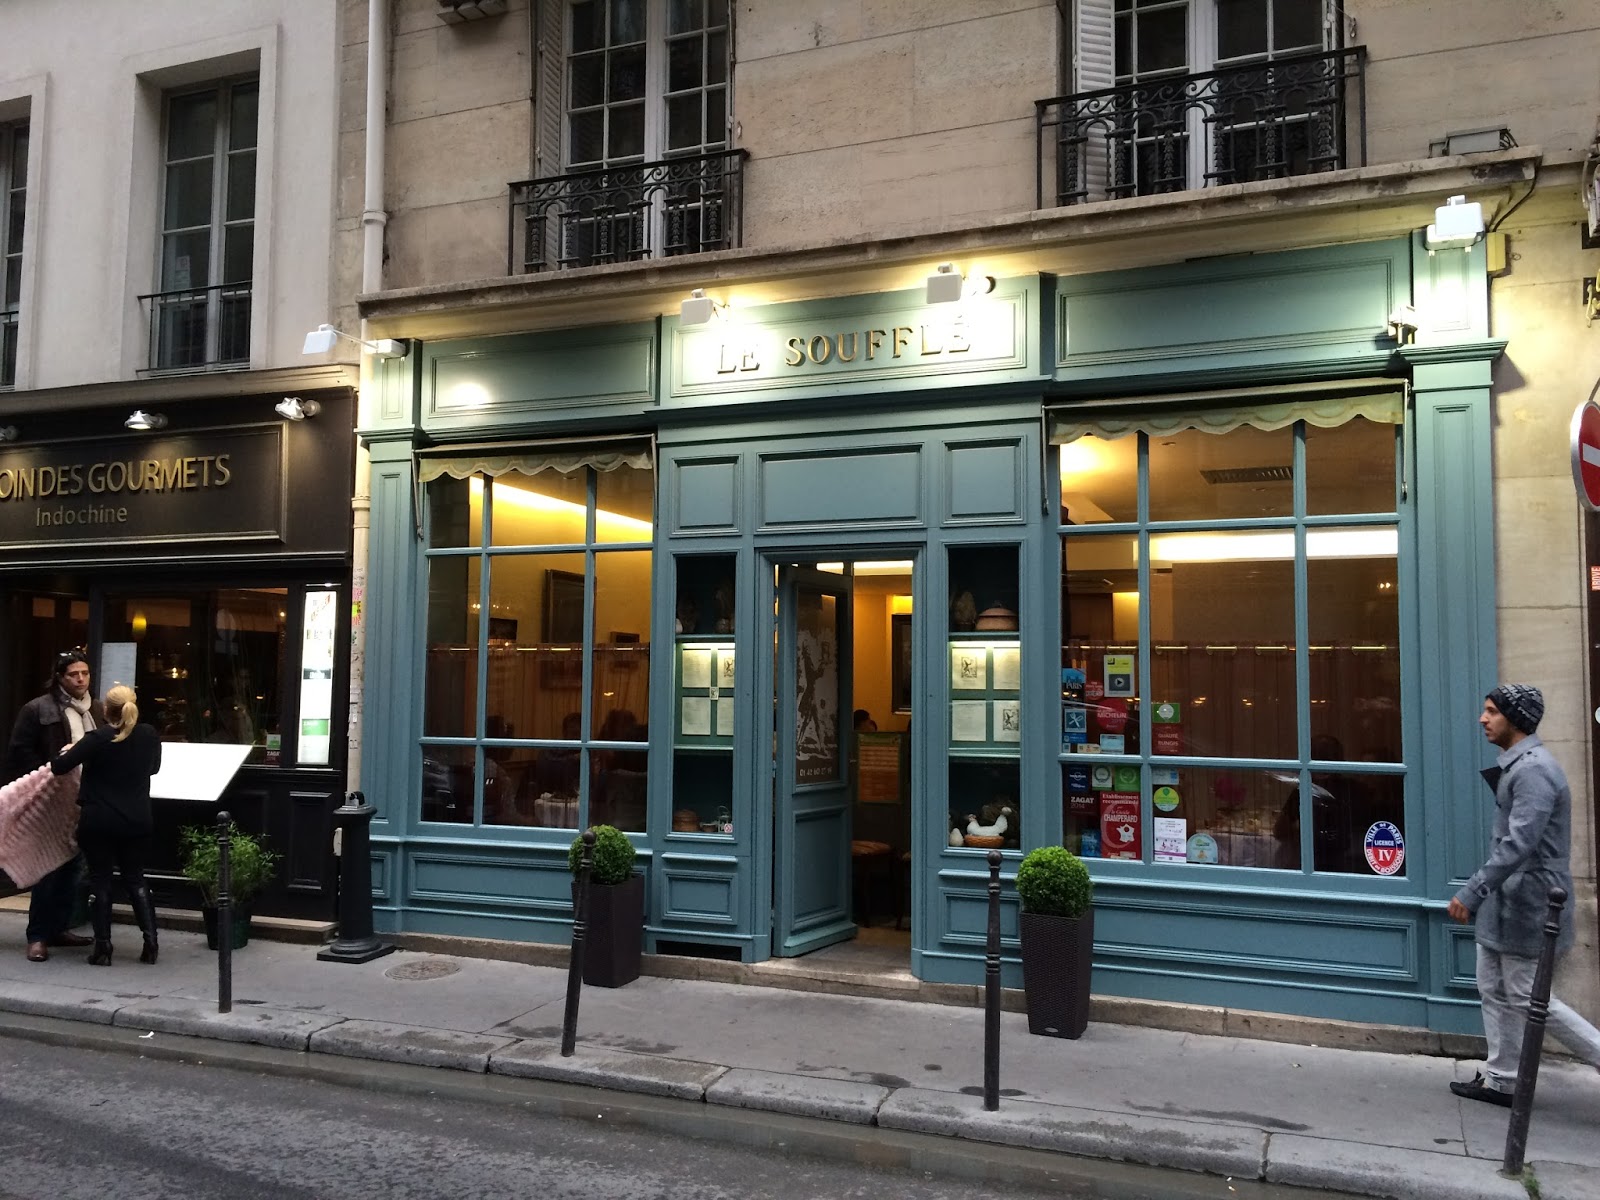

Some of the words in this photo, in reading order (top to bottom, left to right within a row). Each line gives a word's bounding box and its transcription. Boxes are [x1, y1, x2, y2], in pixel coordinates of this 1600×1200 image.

[716, 343, 760, 375] LE
[38, 464, 84, 496] DES
[87, 454, 231, 492] GOURMETS
[36, 503, 128, 526] Indochine
[1070, 796, 1095, 804] ZAGAT
[1103, 813, 1138, 823] CHAMPERARD
[1366, 825, 1379, 843] VILLE
[1388, 824, 1402, 844] PARIS
[1378, 849, 1394, 862] IV
